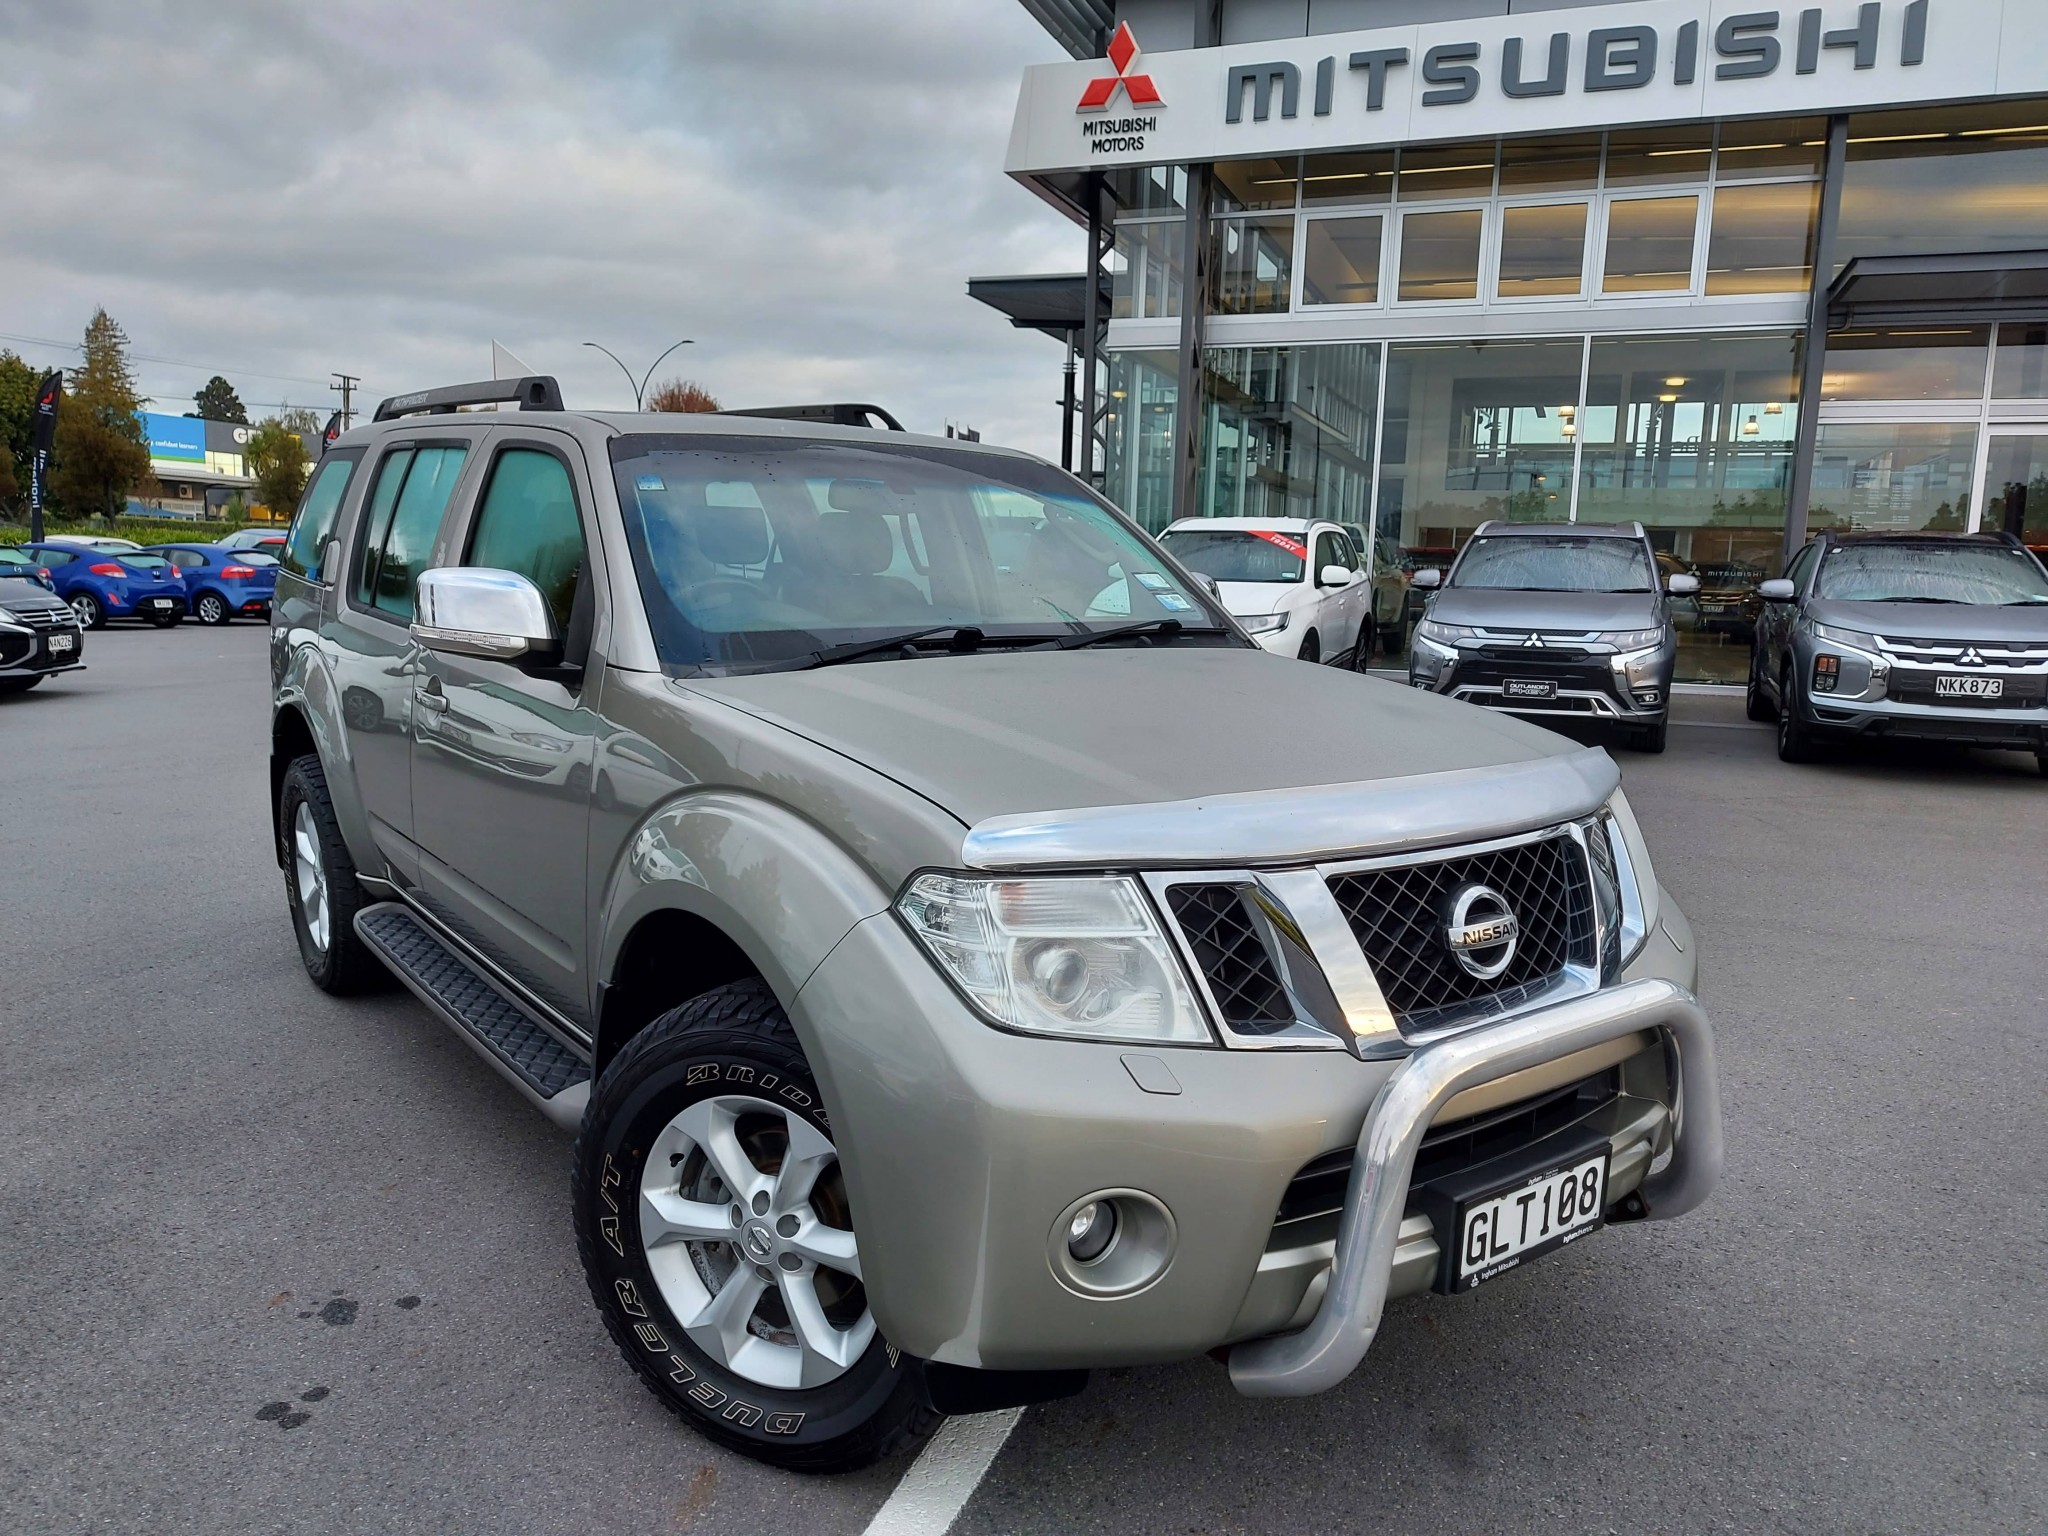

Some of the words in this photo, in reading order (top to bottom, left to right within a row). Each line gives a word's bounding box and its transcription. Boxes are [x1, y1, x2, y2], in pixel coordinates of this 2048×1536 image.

[1226, 0, 1928, 124] MITSUBISHI
[1083, 116, 1157, 137] MITSUBISHI
[1091, 136, 1145, 154] MOTORS
[1270, 536, 1297, 551] TODAY
[49, 636, 71, 648] NAN226
[1937, 678, 2001, 694] NKK873
[1462, 920, 1517, 945] NISSAN
[1465, 1165, 1599, 1267] GLT108
[1481, 1267, 1498, 1280] Ingham
[1498, 1256, 1521, 1272] Mitsubishi
[614, 1277, 807, 1437] DUELER
